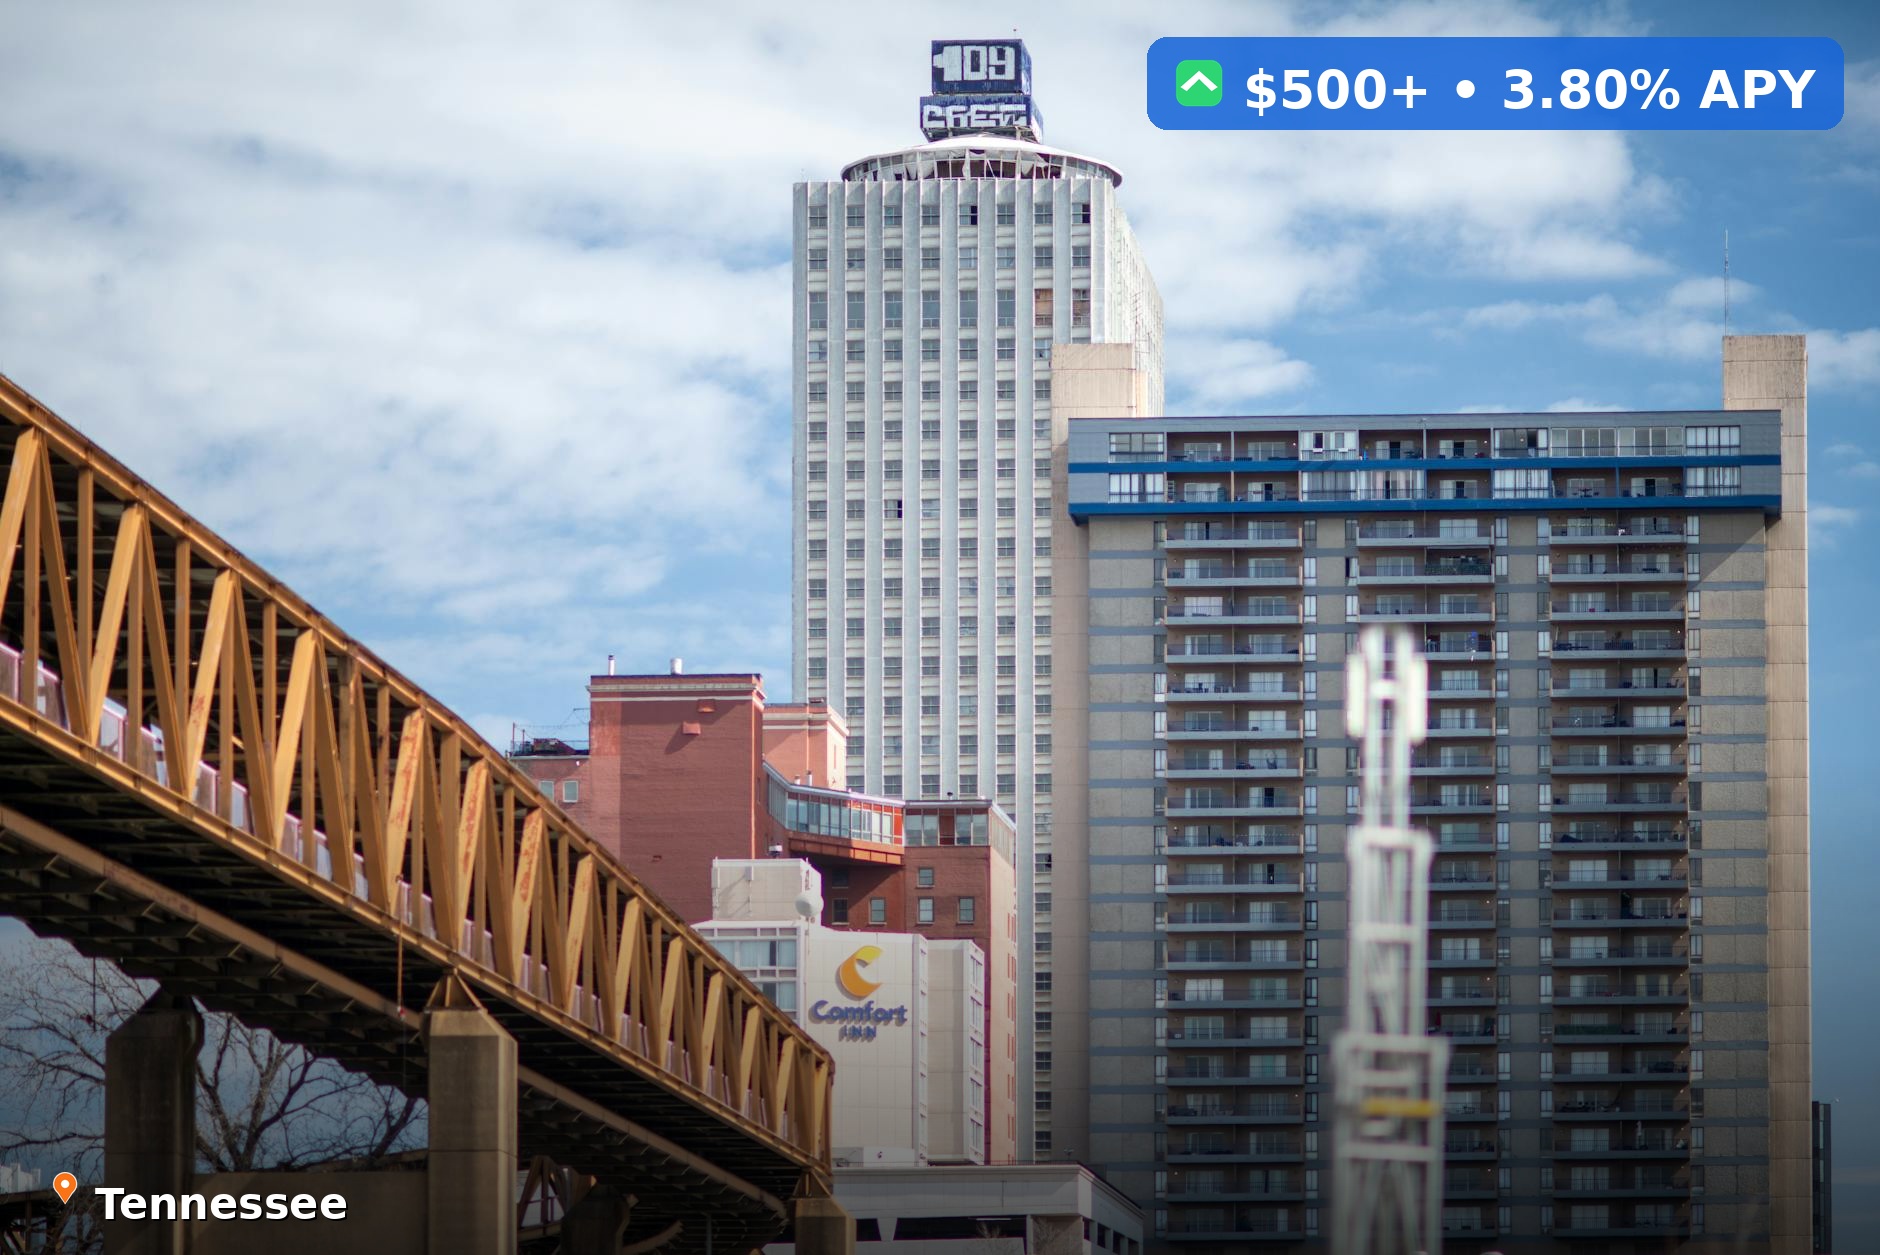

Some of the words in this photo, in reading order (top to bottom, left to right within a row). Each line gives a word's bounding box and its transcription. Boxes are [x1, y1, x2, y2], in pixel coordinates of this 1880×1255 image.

[932, 45, 1016, 81] 109
[812, 1000, 908, 1023] Comfort
[841, 1025, 877, 1039] INN
